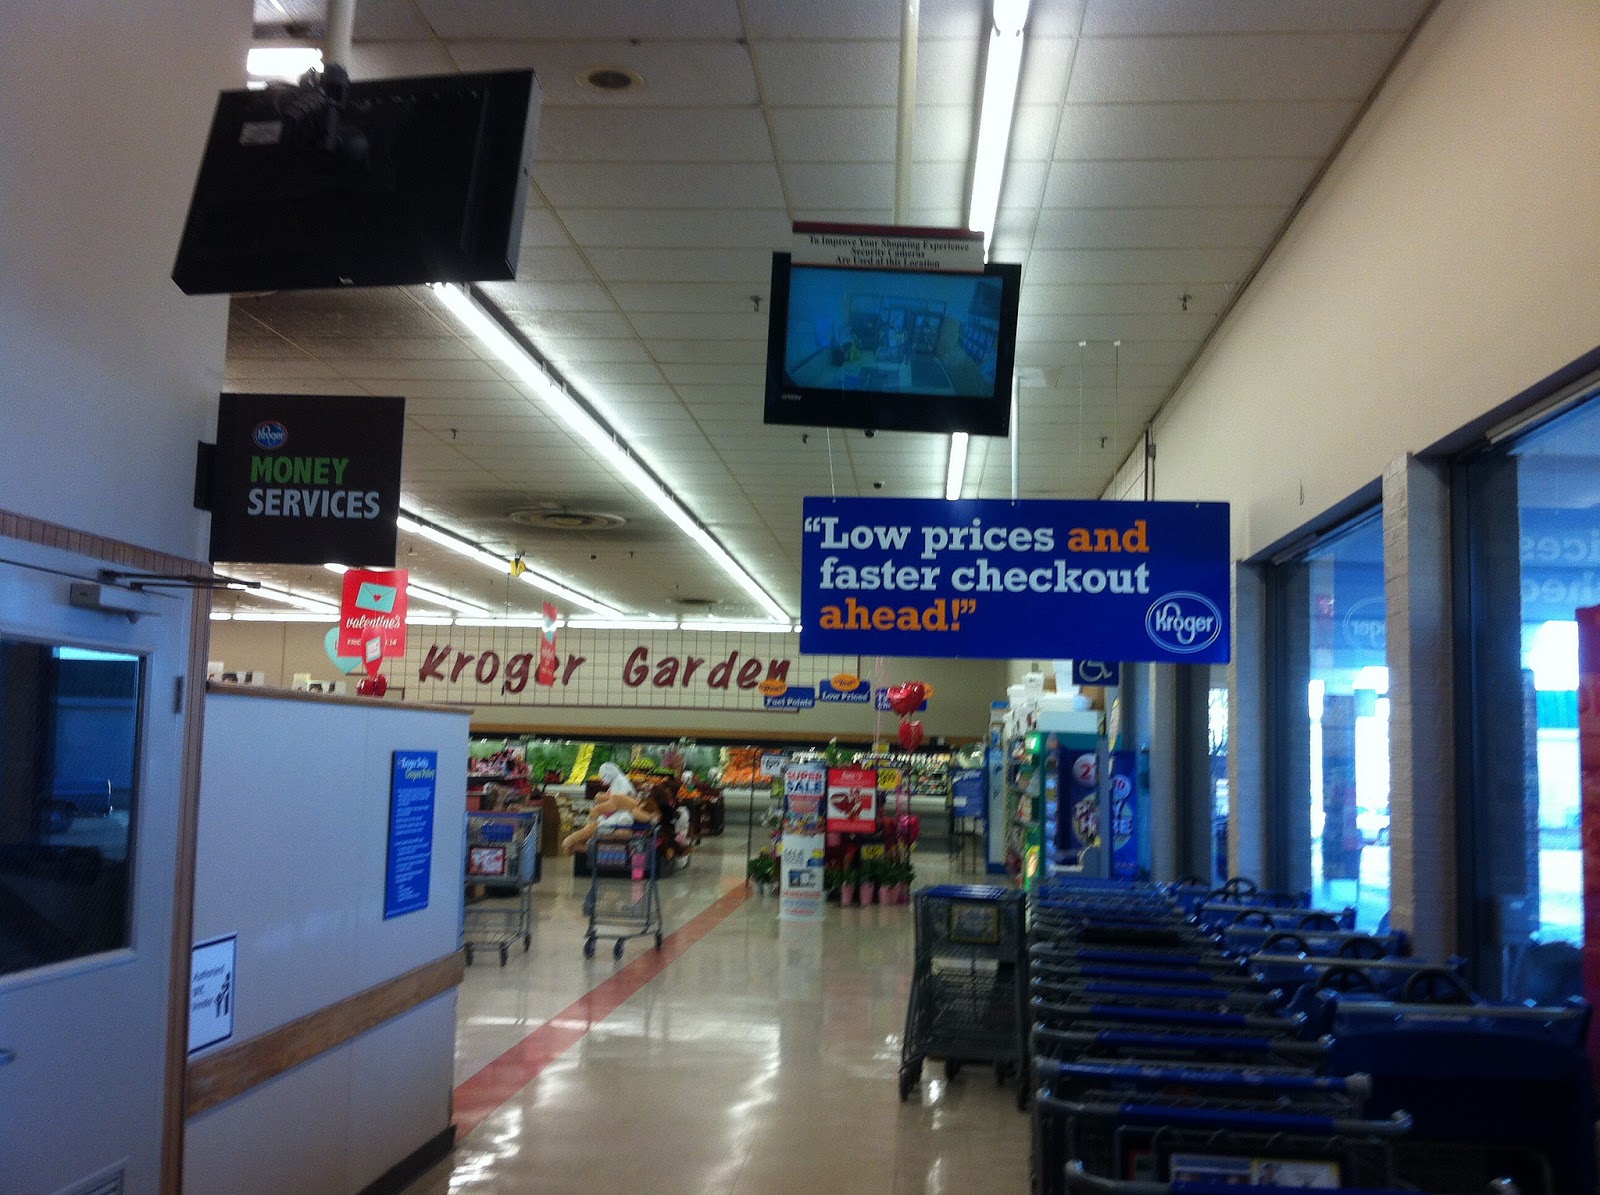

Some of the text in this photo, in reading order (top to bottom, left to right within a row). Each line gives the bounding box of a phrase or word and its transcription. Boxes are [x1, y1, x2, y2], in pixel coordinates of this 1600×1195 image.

[821, 236, 857, 249] Improve
[859, 238, 879, 248] Your
[881, 240, 920, 252] Shopping
[923, 241, 970, 253] Experience
[850, 247, 926, 260] Security Cameras
[886, 258, 902, 268] this
[903, 257, 940, 269] Location
[251, 456, 349, 485] MONEY
[247, 489, 381, 520] SERVICES
[922, 518, 1055, 559] prices
[1068, 521, 1150, 553] and
[820, 556, 1150, 595] faster checkout
[1155, 602, 1215, 644] Kroger
[622, 645, 790, 690] Garden
[822, 690, 841, 701] Low
[787, 781, 823, 794] SALE
